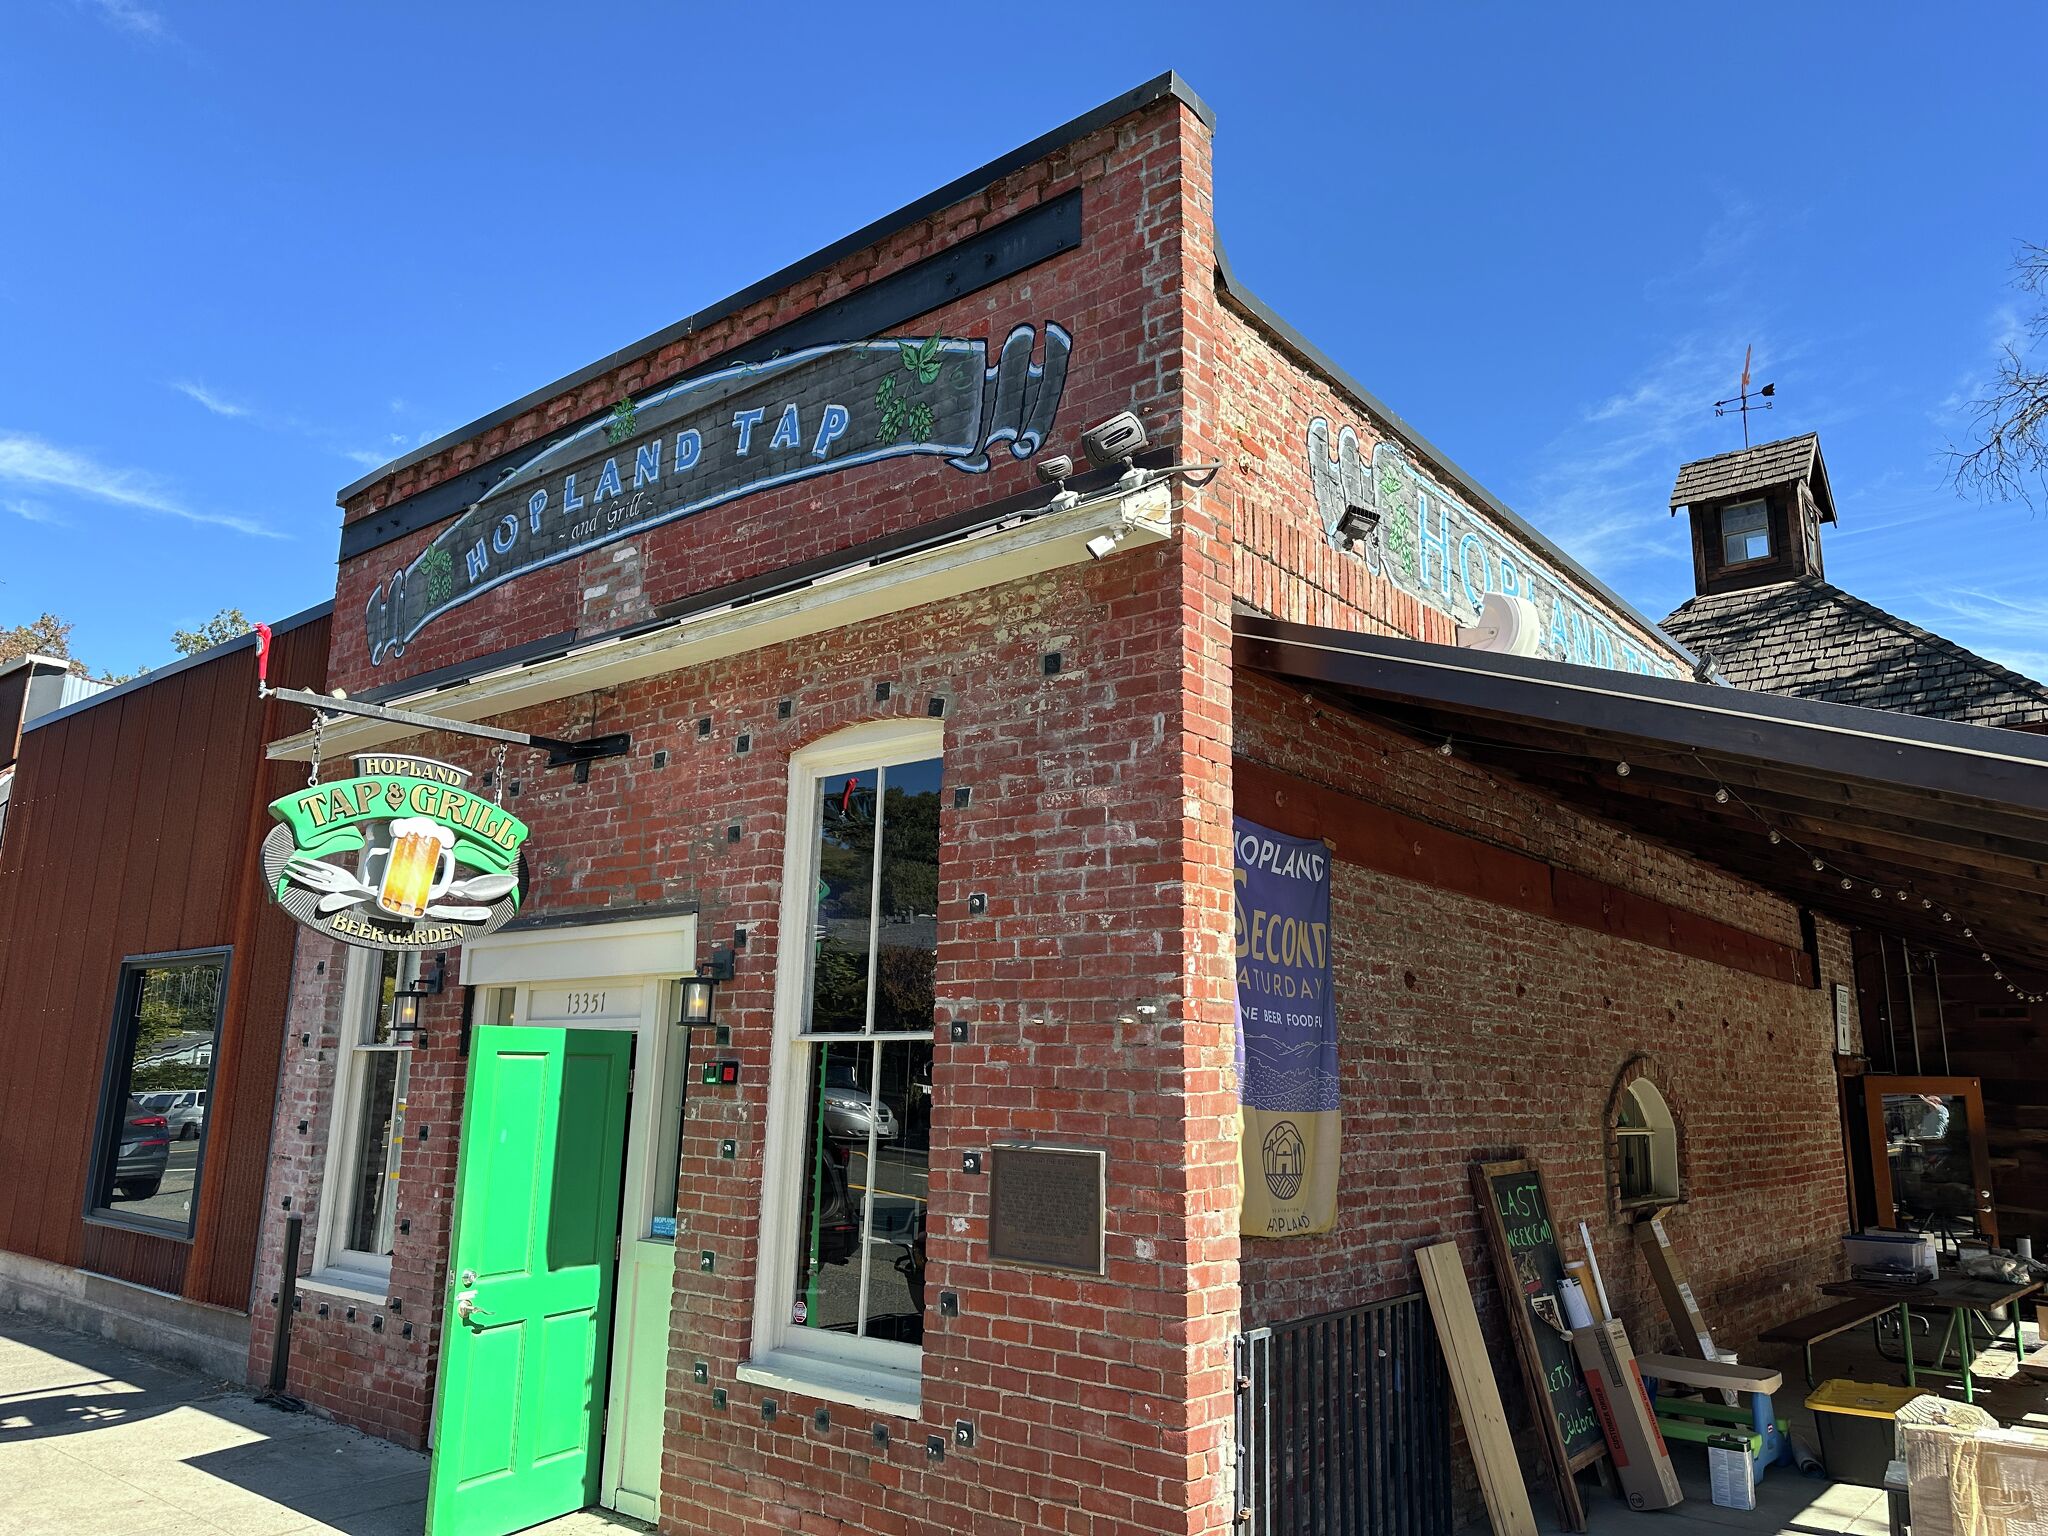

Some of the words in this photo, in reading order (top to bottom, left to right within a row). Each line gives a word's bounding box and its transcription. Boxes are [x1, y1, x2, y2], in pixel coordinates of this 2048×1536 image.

[1715, 408, 1724, 417] N
[466, 428, 702, 584] HOPLAND
[733, 402, 851, 459] TAP
[571, 507, 602, 540] and
[607, 491, 645, 531] Grill
[365, 758, 462, 786] HOPLAND
[299, 780, 382, 828] TAP
[385, 782, 406, 812] &
[409, 783, 518, 851] GRILL
[331, 914, 385, 943] BEER
[386, 924, 465, 946] GARDEN
[1238, 965, 1322, 1000] ATURDAY
[567, 991, 605, 1015] 13351
[1264, 1009, 1282, 1024] BEER
[1286, 1013, 1313, 1027] FOOD
[1496, 1185, 1541, 1218] LAST
[1507, 1219, 1554, 1248] WEEKEND
[1544, 1360, 1572, 1393] LET'S
[1557, 1407, 1599, 1444] Celebrat
